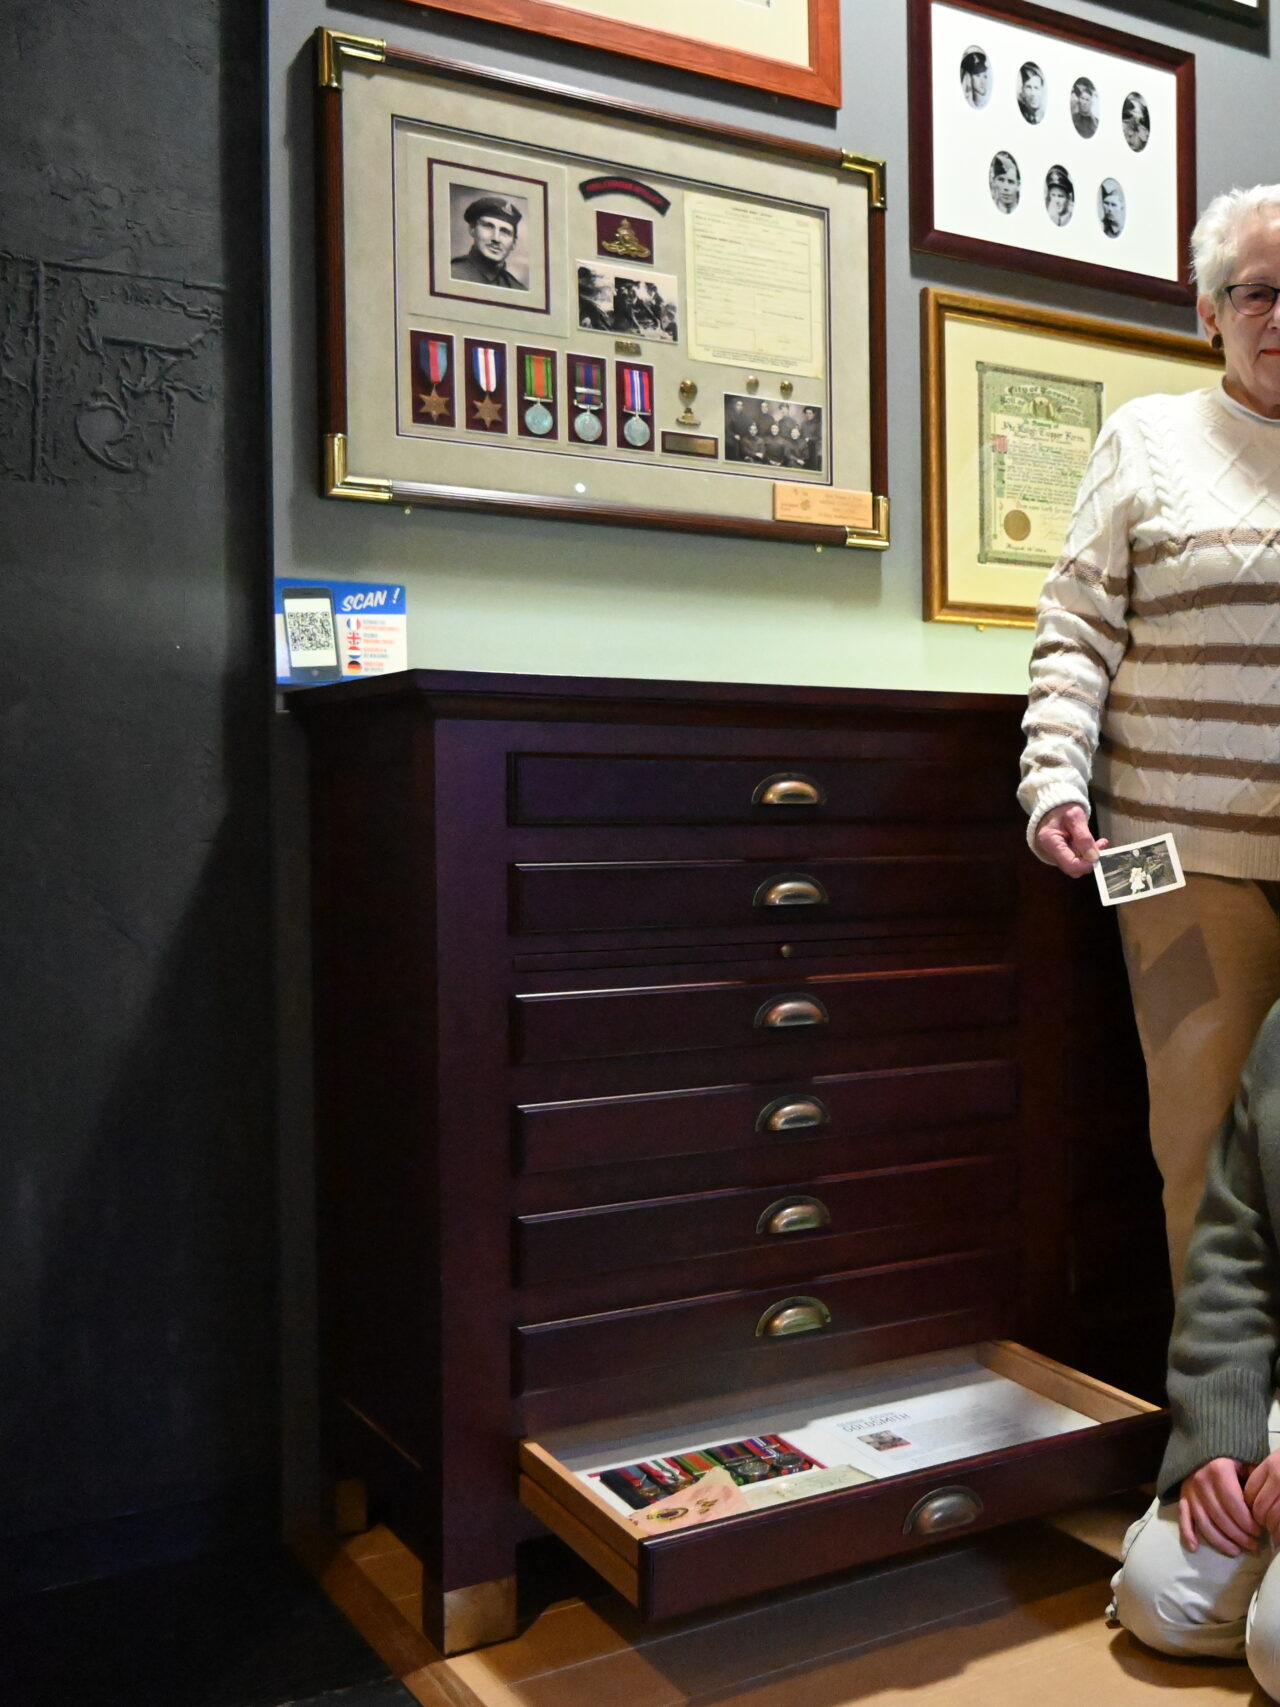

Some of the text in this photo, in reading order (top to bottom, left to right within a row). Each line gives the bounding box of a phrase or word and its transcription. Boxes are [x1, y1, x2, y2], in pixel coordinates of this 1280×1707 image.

[341, 587, 400, 612] SCAN !
[842, 1412, 911, 1433] GOLDSMITH
